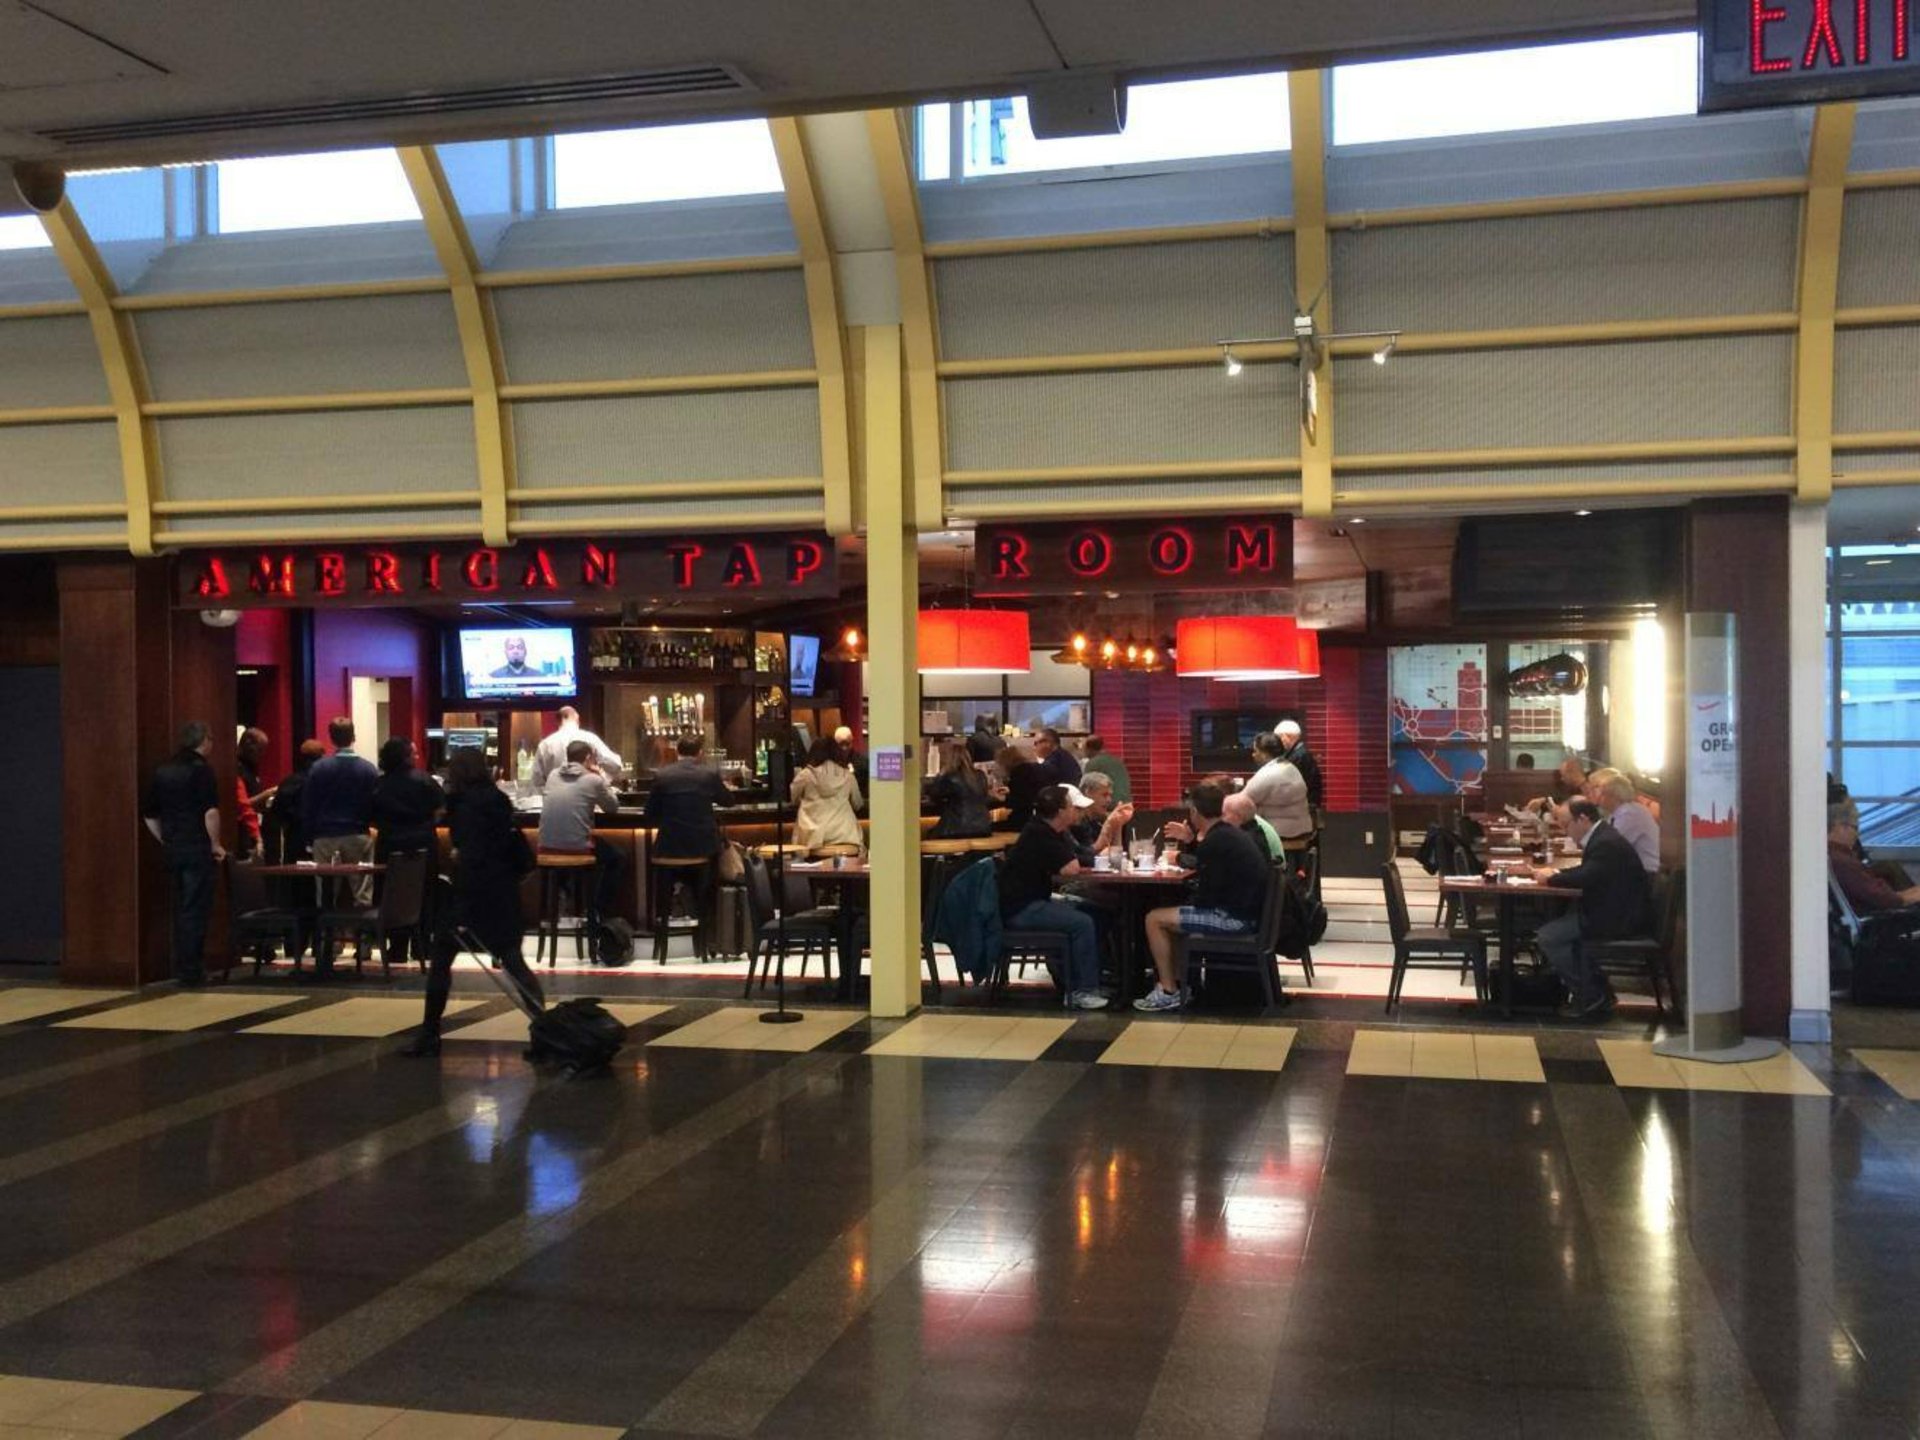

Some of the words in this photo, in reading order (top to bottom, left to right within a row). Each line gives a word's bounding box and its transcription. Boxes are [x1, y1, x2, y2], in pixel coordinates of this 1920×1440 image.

[192, 544, 617, 597] AMERICAN
[667, 541, 823, 588] TAP
[991, 523, 1275, 579] ROOM
[1708, 722, 1733, 736] GR
[1701, 738, 1733, 752] OPE
